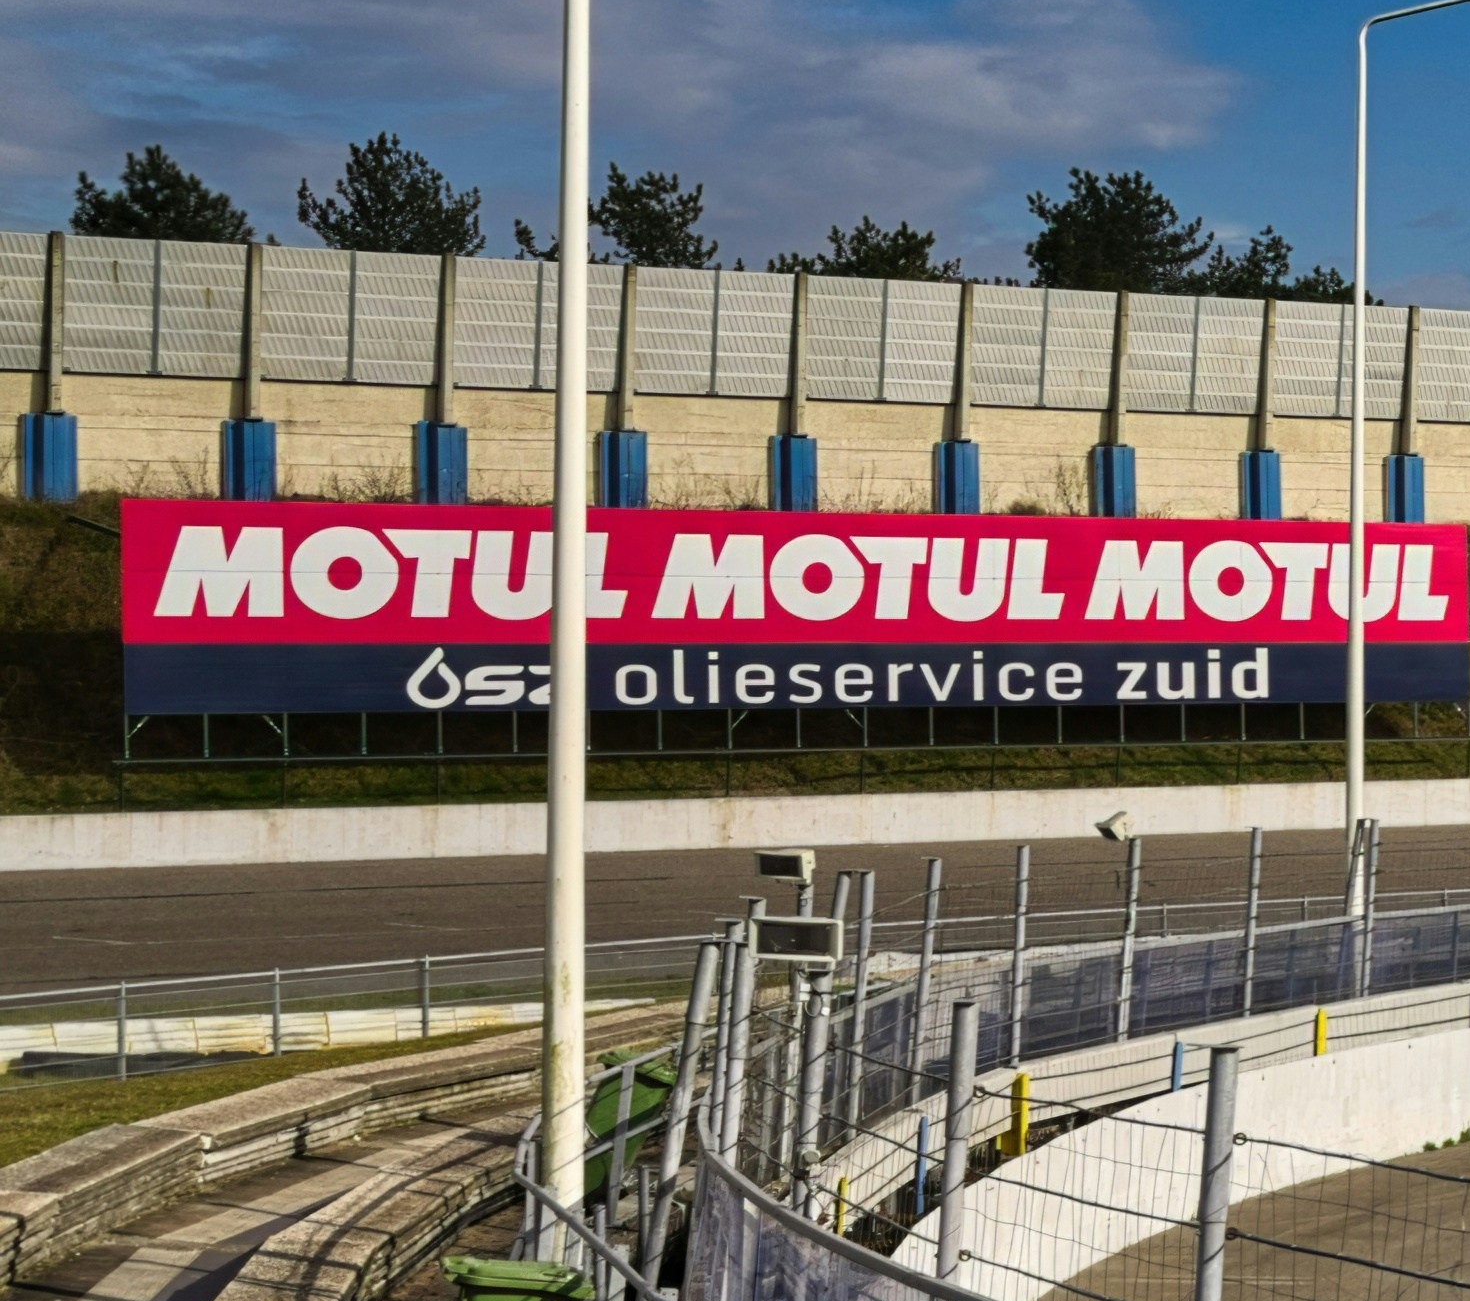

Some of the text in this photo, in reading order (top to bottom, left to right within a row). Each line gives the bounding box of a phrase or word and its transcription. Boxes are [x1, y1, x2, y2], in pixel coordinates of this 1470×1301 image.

[153, 525, 1449, 622] MOTUL MOTUL MOTUL
[614, 648, 1083, 704] olieservice
[1116, 646, 1269, 700] zuid
